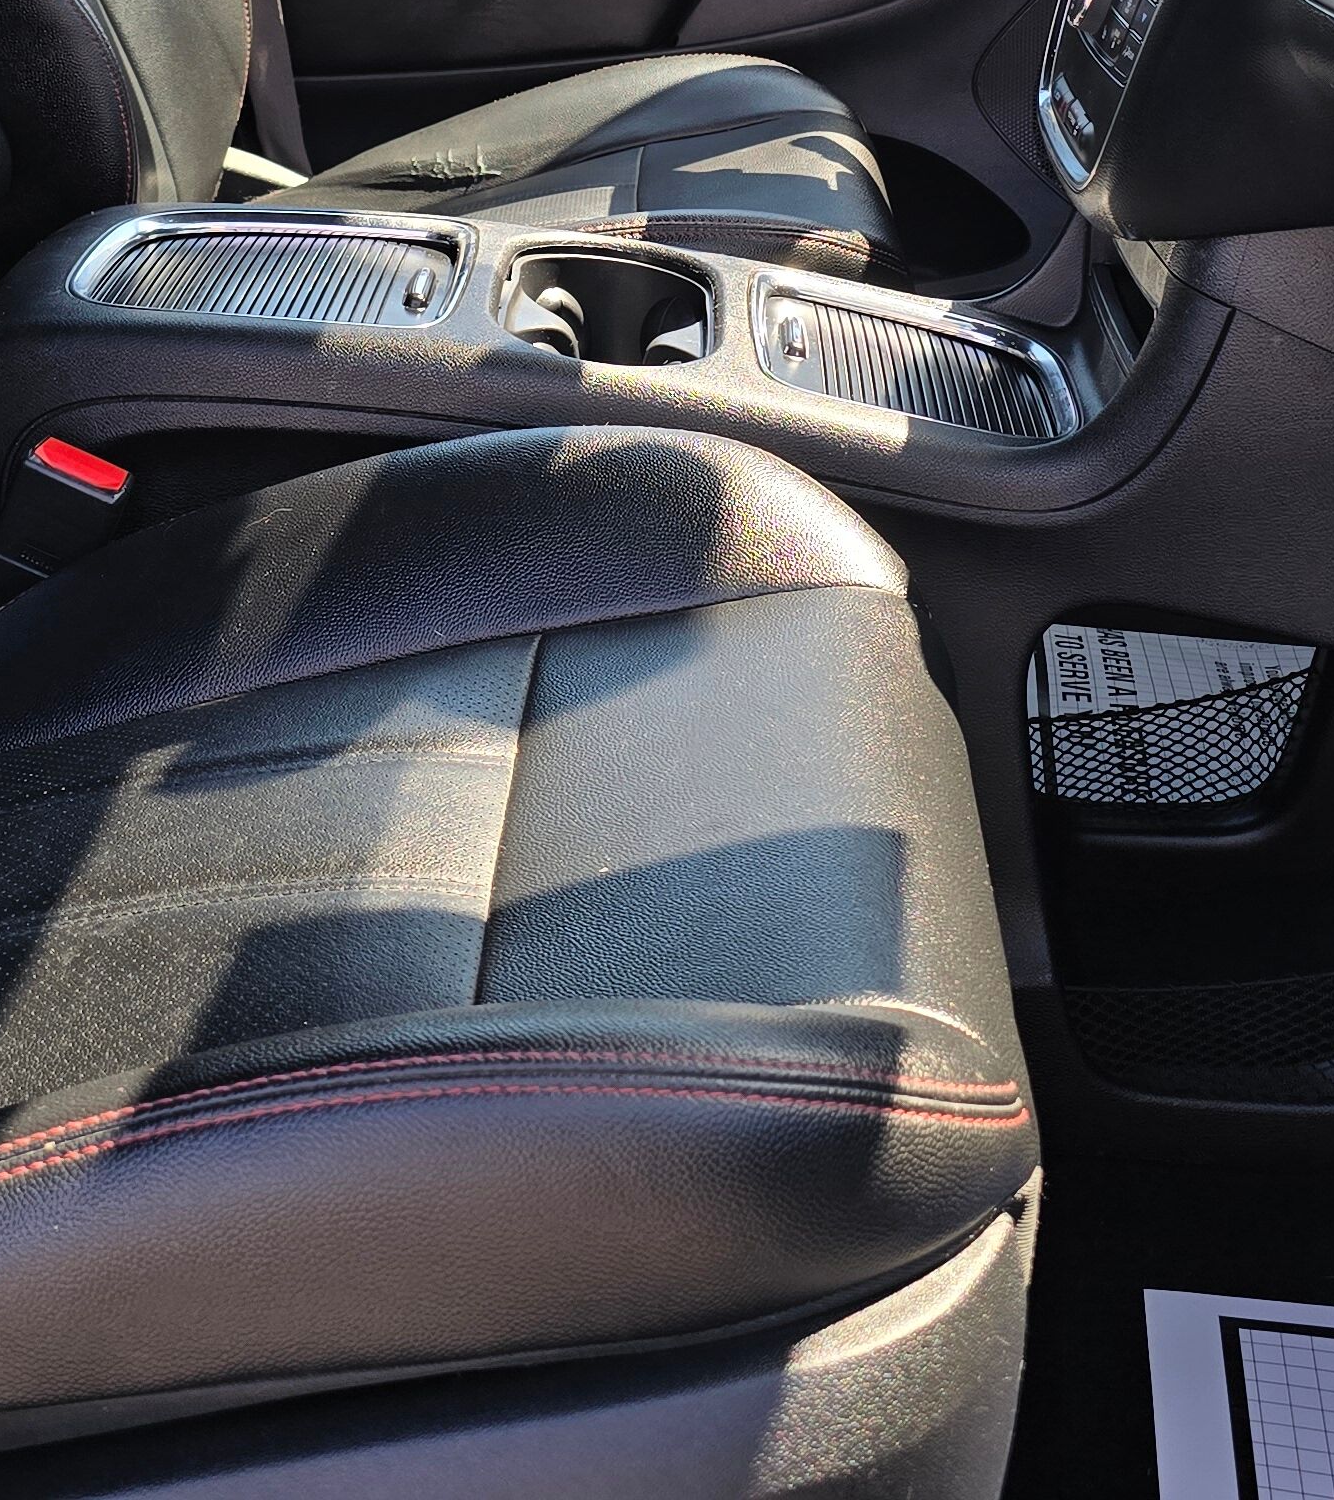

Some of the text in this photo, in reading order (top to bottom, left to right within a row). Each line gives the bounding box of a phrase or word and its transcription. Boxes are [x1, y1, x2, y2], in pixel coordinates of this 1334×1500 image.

[1054, 635, 1085, 649] TO
[1056, 651, 1092, 703] SERVE
[1100, 648, 1136, 683] BEEN
[1107, 685, 1138, 697] A
